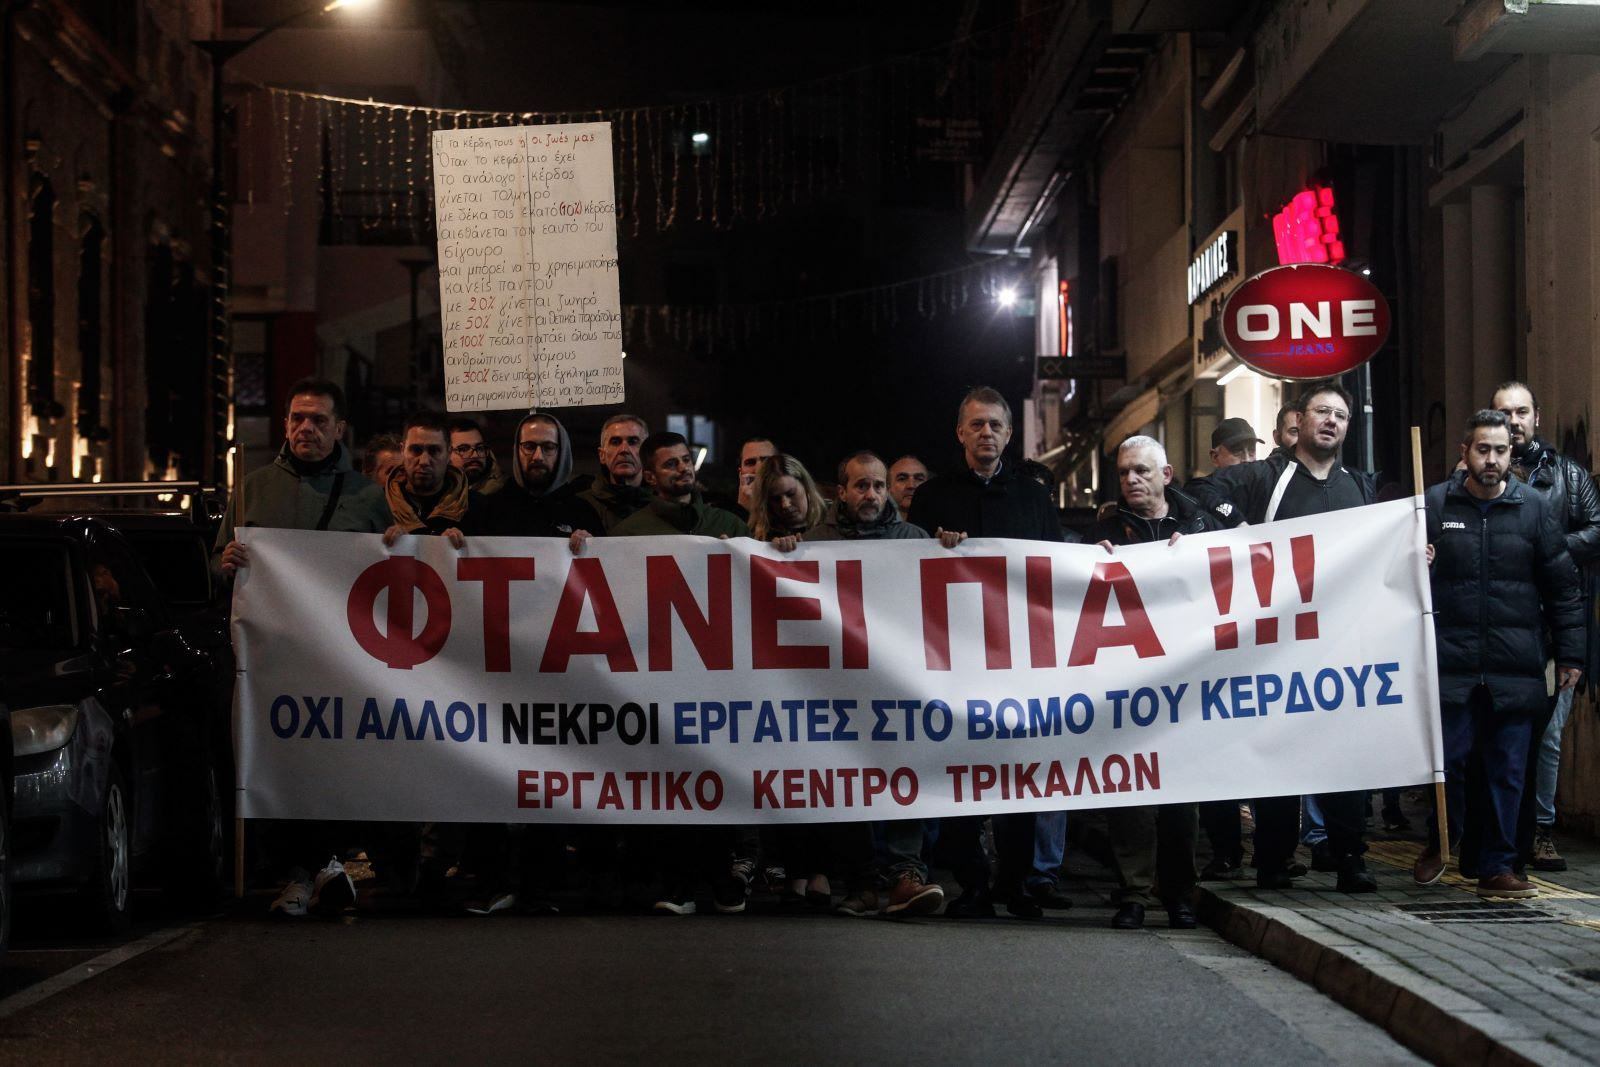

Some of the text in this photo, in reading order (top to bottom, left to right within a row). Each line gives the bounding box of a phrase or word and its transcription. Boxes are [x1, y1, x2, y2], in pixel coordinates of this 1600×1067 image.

[463, 136, 492, 151] κέρδη
[493, 138, 514, 146] τους
[532, 136, 542, 144] οι
[573, 134, 594, 149] μας
[437, 150, 576, 168] Όταν το κεφάλαιο έχει
[439, 167, 575, 186] το ανάλογο κέρδος
[439, 190, 482, 208] γίνεται
[438, 212, 453, 226] με
[458, 208, 488, 220] δέκα
[493, 210, 514, 219] τοις
[542, 219, 578, 234] εαυτό
[585, 222, 603, 232] του
[444, 242, 503, 263] σίγουρο
[445, 278, 491, 292] κανείς
[446, 292, 597, 319] με 20% γίνεται ζωηρό
[444, 321, 460, 337] με
[465, 314, 493, 329] 50%
[1236, 299, 1378, 342] ONE
[444, 338, 458, 352] με
[460, 334, 484, 347] 100%
[1288, 342, 1336, 356] JEANS
[533, 348, 576, 366] νόμους
[446, 375, 461, 392] με
[463, 369, 490, 384] 300%
[492, 370, 510, 382] δεν
[603, 367, 622, 376] που
[347, 554, 869, 673] ΦΤΑΝΕΙ
[920, 556, 1166, 670] ΠΙΑ
[270, 662, 1403, 745] ΟΧΙ ΑΛΛΟΙ ΝΕΚΡΟΙ ΕΡΓΑΤΕΣ ΣΤΟ ΒΩΜΟ ΤΟΥ ΚΕΡΔΟΥΣ
[518, 751, 1161, 811] ΕΡΓΑΤΙΚΟ ΚΕΝΤΡΟ ΤΡΙΚΑΛΩΝ
